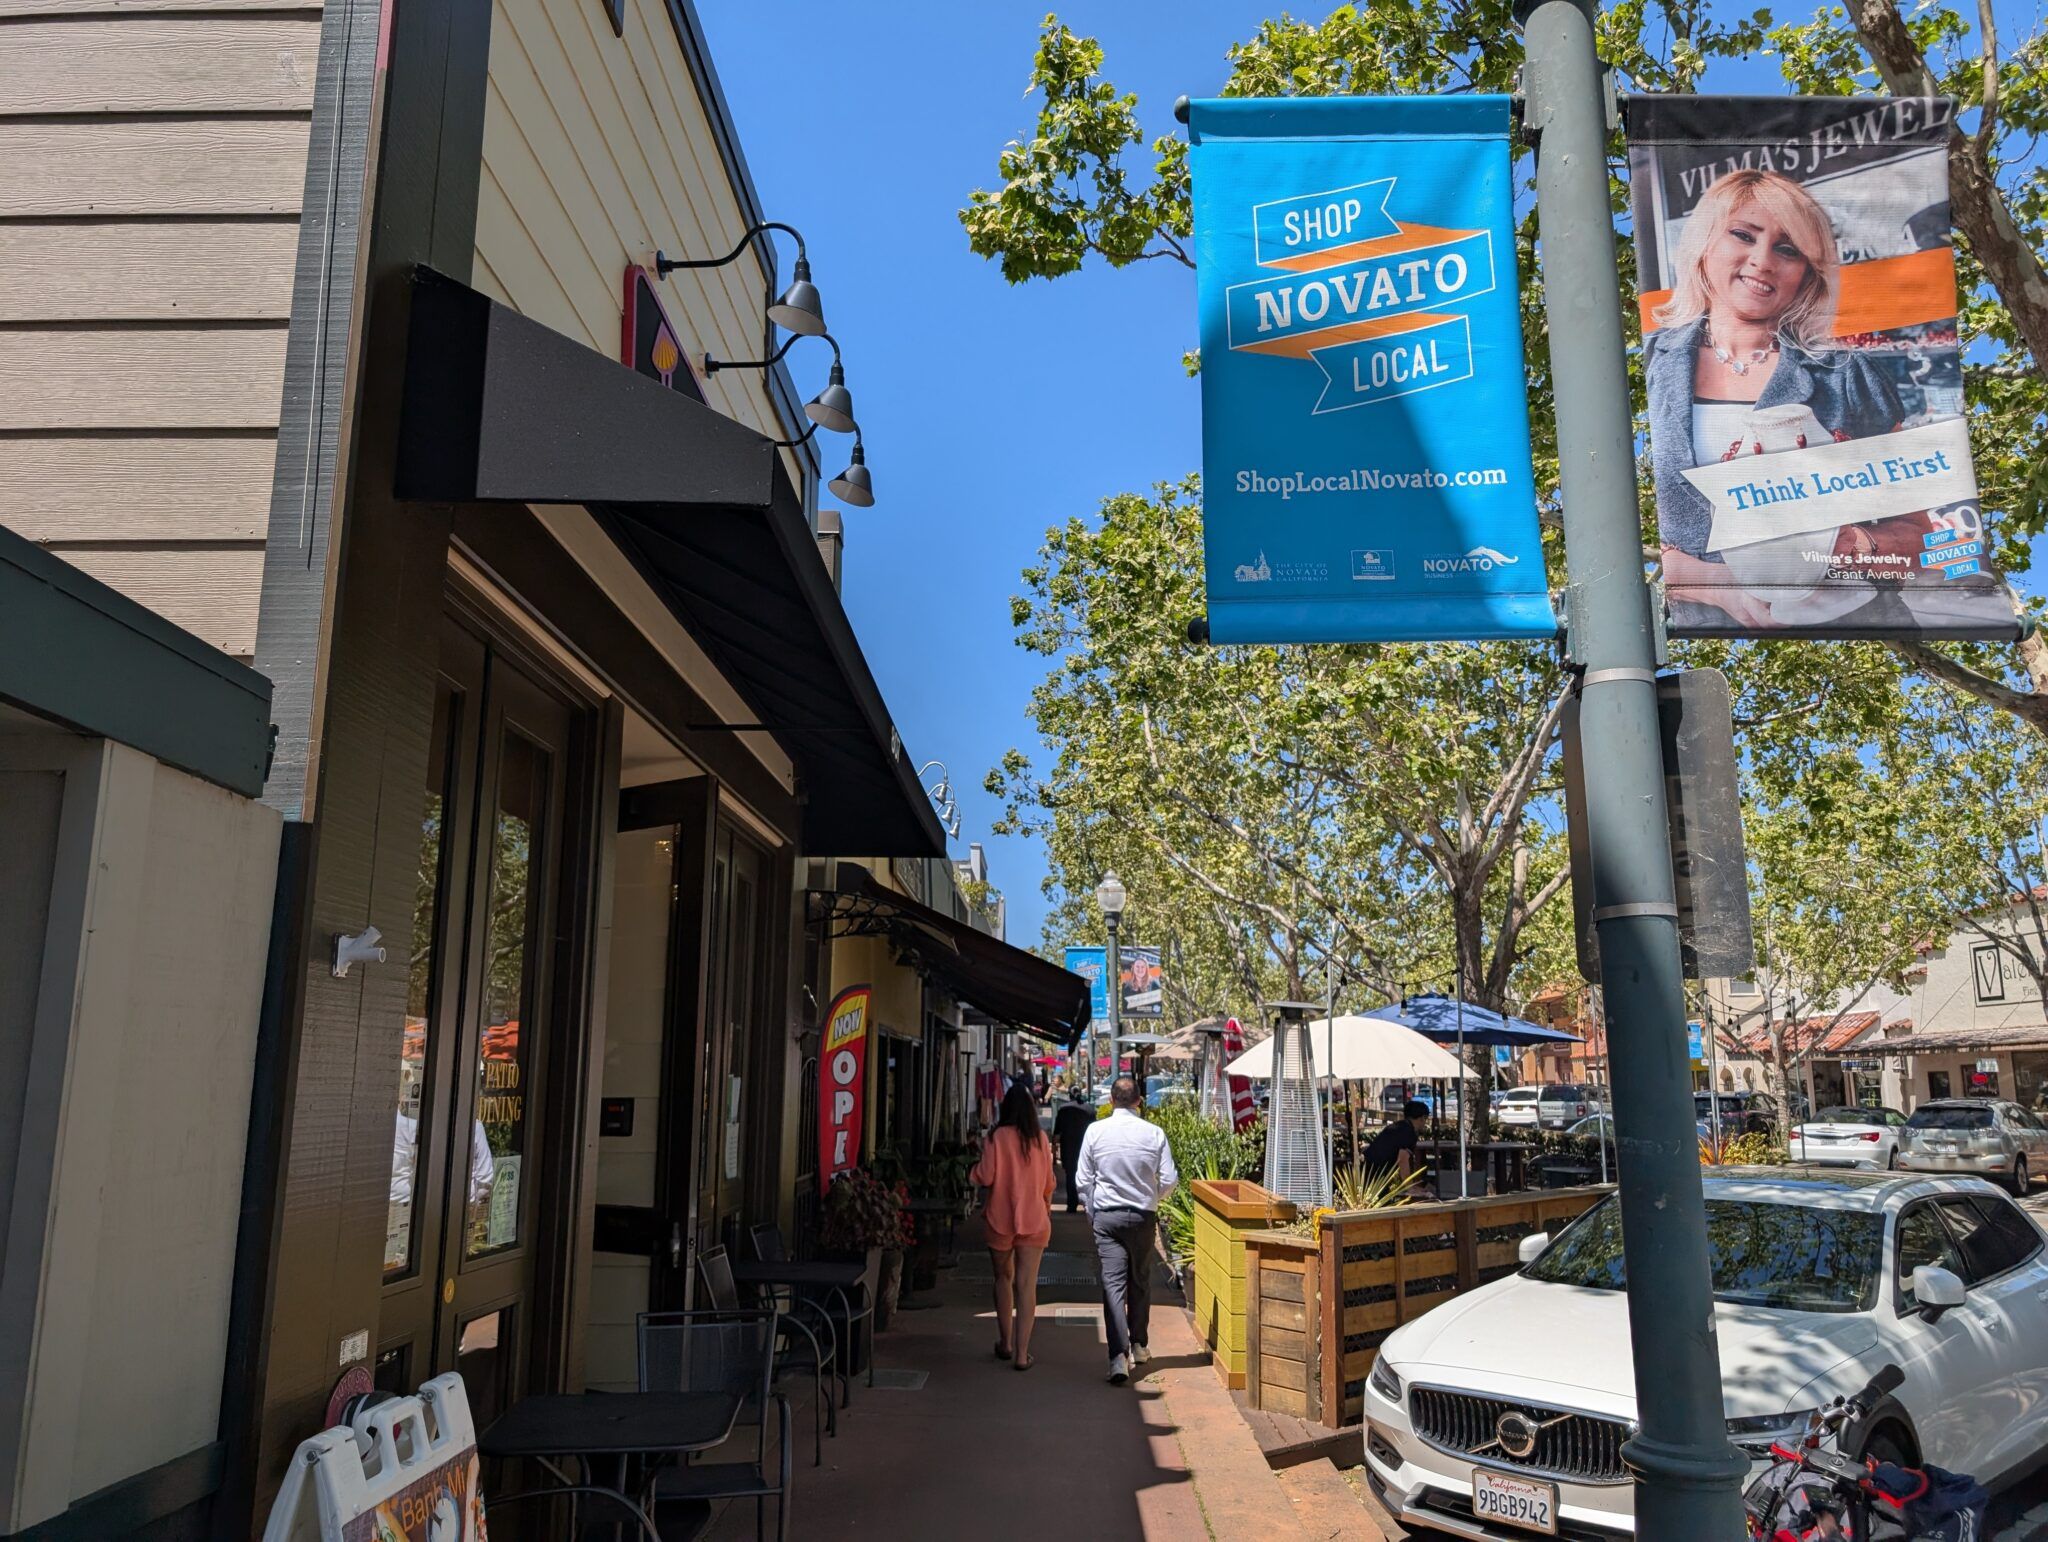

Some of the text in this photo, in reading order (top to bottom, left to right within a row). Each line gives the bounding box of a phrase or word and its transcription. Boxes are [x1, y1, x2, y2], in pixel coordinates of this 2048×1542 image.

[1284, 199, 1361, 245] SHOP
[1255, 254, 1467, 332] NOVATO
[1353, 340, 1449, 392] LOCAL
[1236, 468, 1507, 499] ShopLocalNovato.com
[1727, 450, 1951, 511] Think Local First
[1930, 533, 1949, 544] SHOP
[1423, 558, 1493, 572] NOVATO
[1802, 551, 1911, 568] Vilma's Jewelry
[1927, 544, 1976, 564] NOVATO
[1827, 568, 1915, 580] Grant Avenue
[1952, 563, 1974, 575] LOCAL
[834, 1007, 862, 1041] NOW
[485, 1062, 520, 1089] PATIO
[478, 1096, 522, 1124] DINING
[832, 1050, 857, 1181] OPE
[1489, 1478, 1537, 1496] California
[402, 1481, 445, 1532] Banh
[1479, 1489, 1548, 1525] 9BGB942
